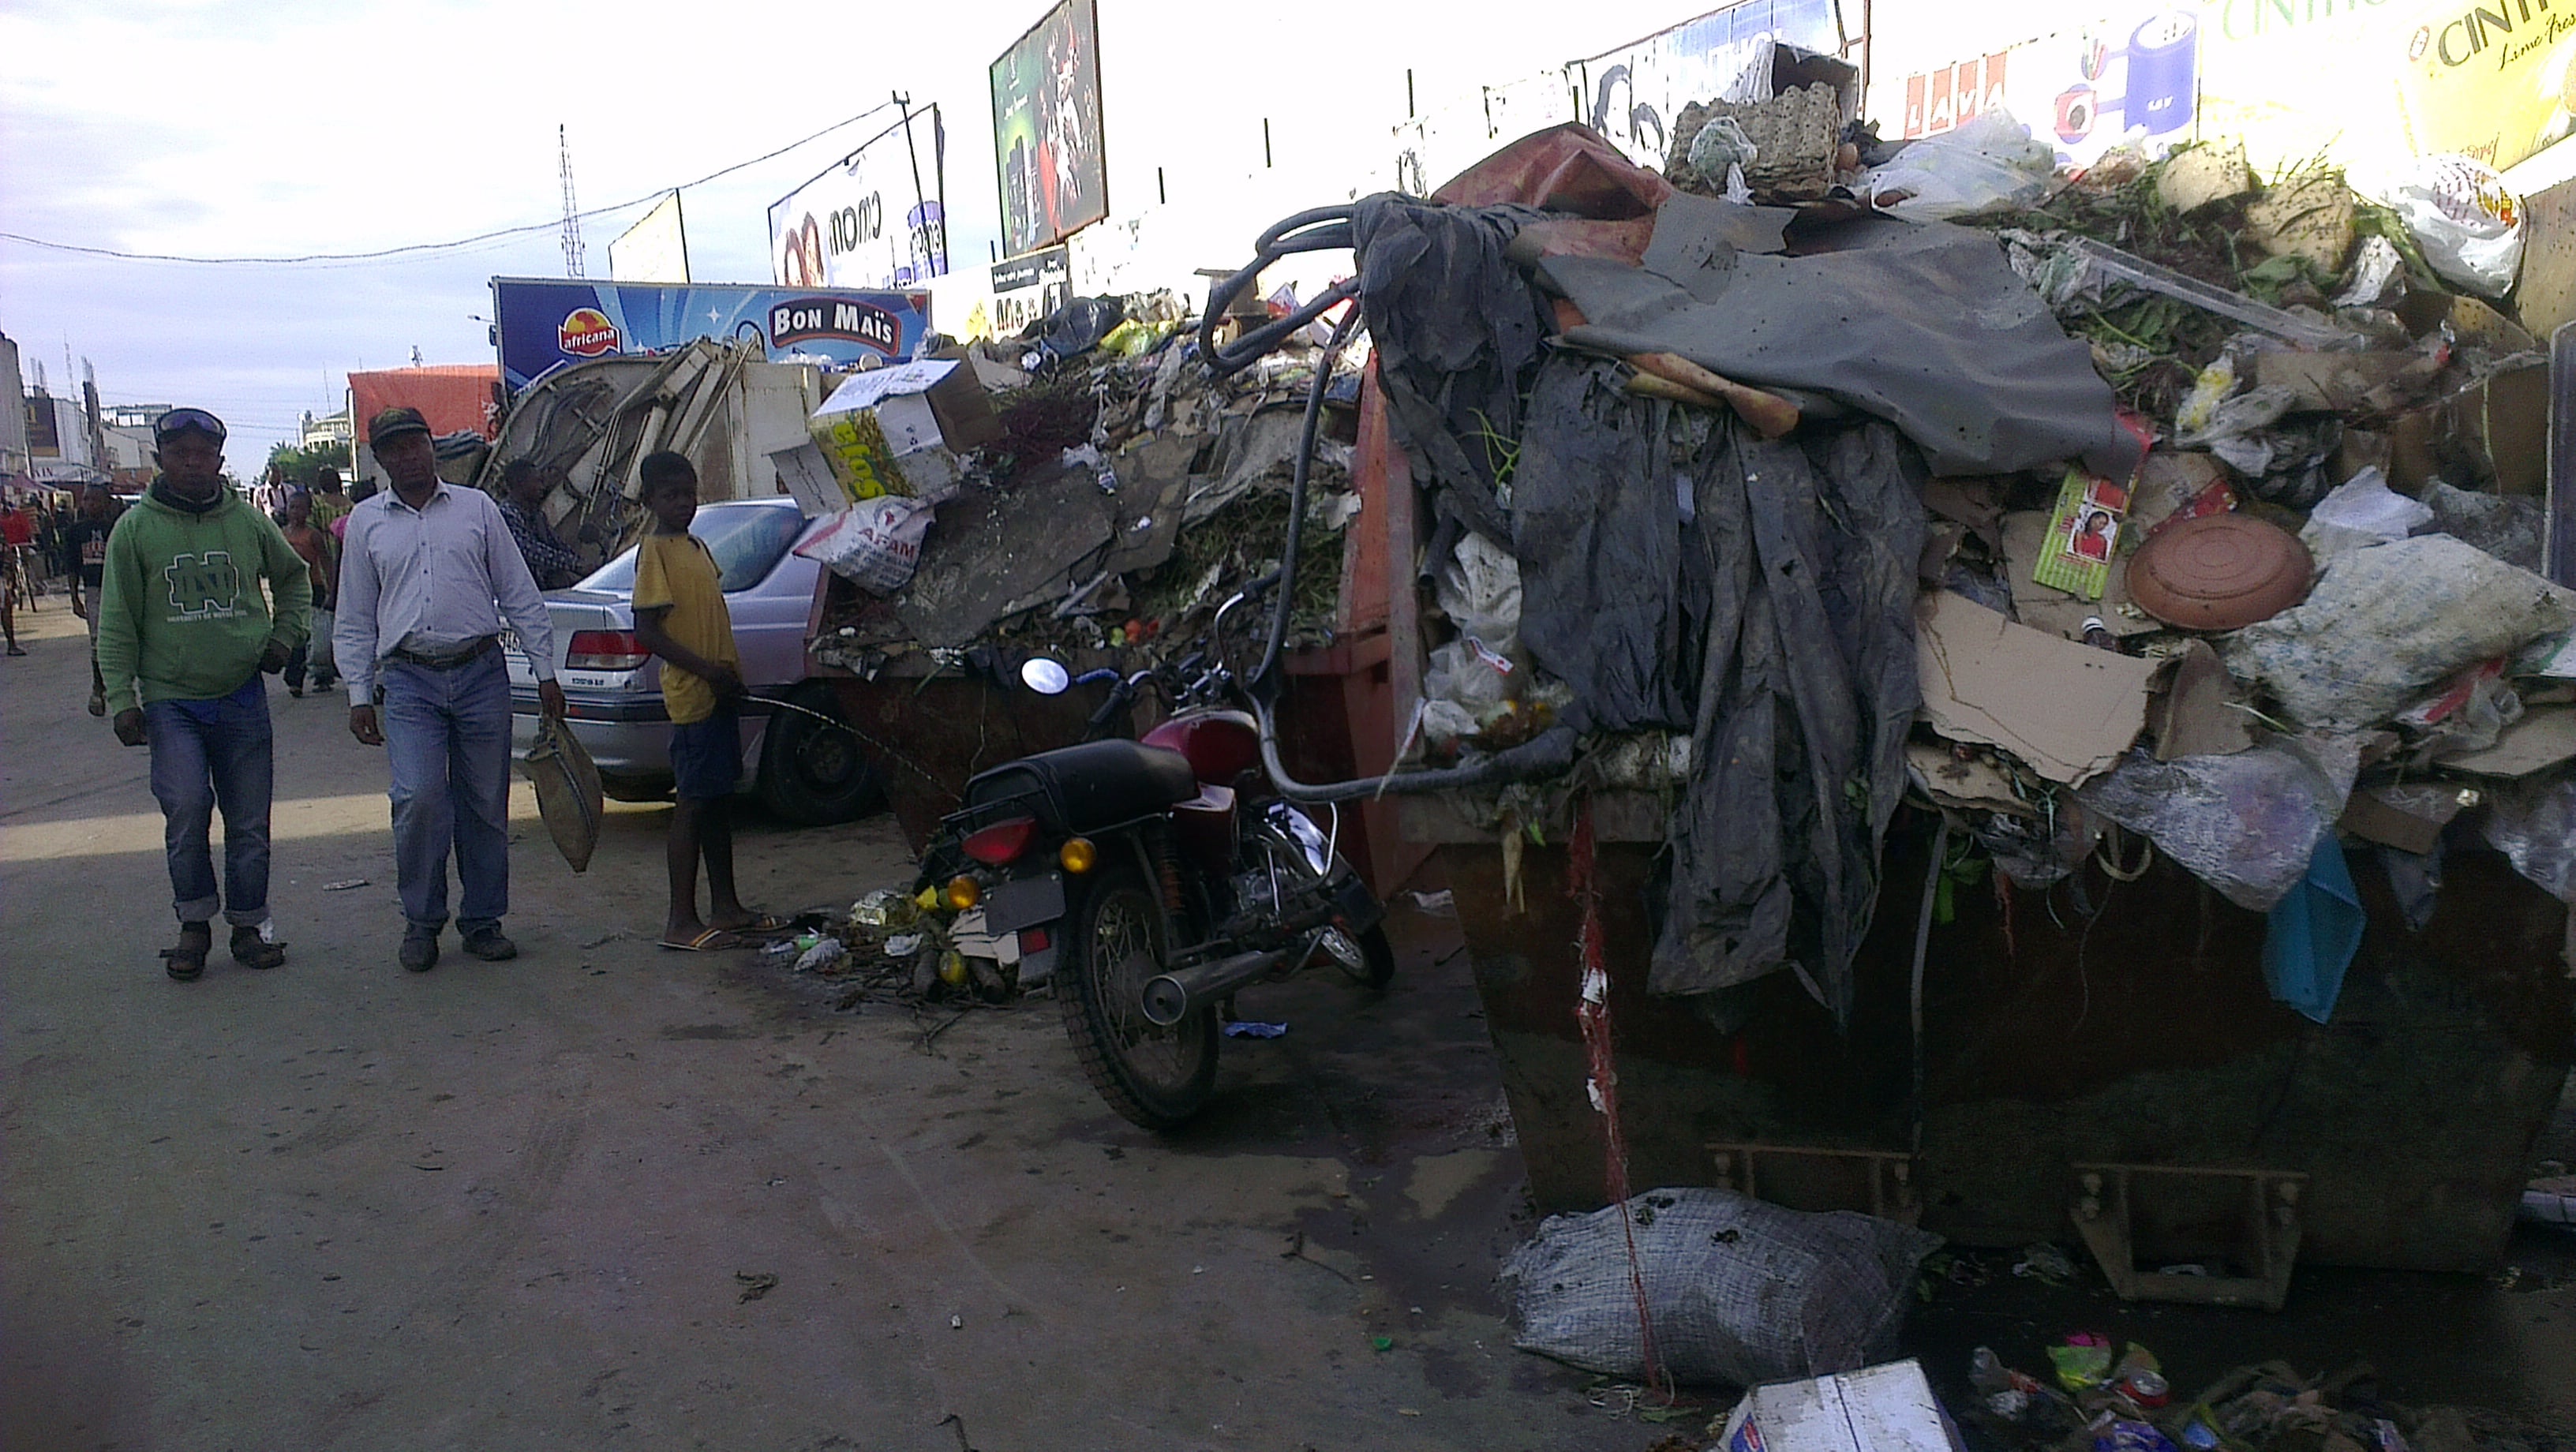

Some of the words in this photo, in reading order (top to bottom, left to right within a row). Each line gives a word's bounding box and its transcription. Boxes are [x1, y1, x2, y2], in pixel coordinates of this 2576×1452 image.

[2438, 0, 2548, 67] CIN
[774, 307, 822, 337] BON
[564, 329, 615, 349] africana
